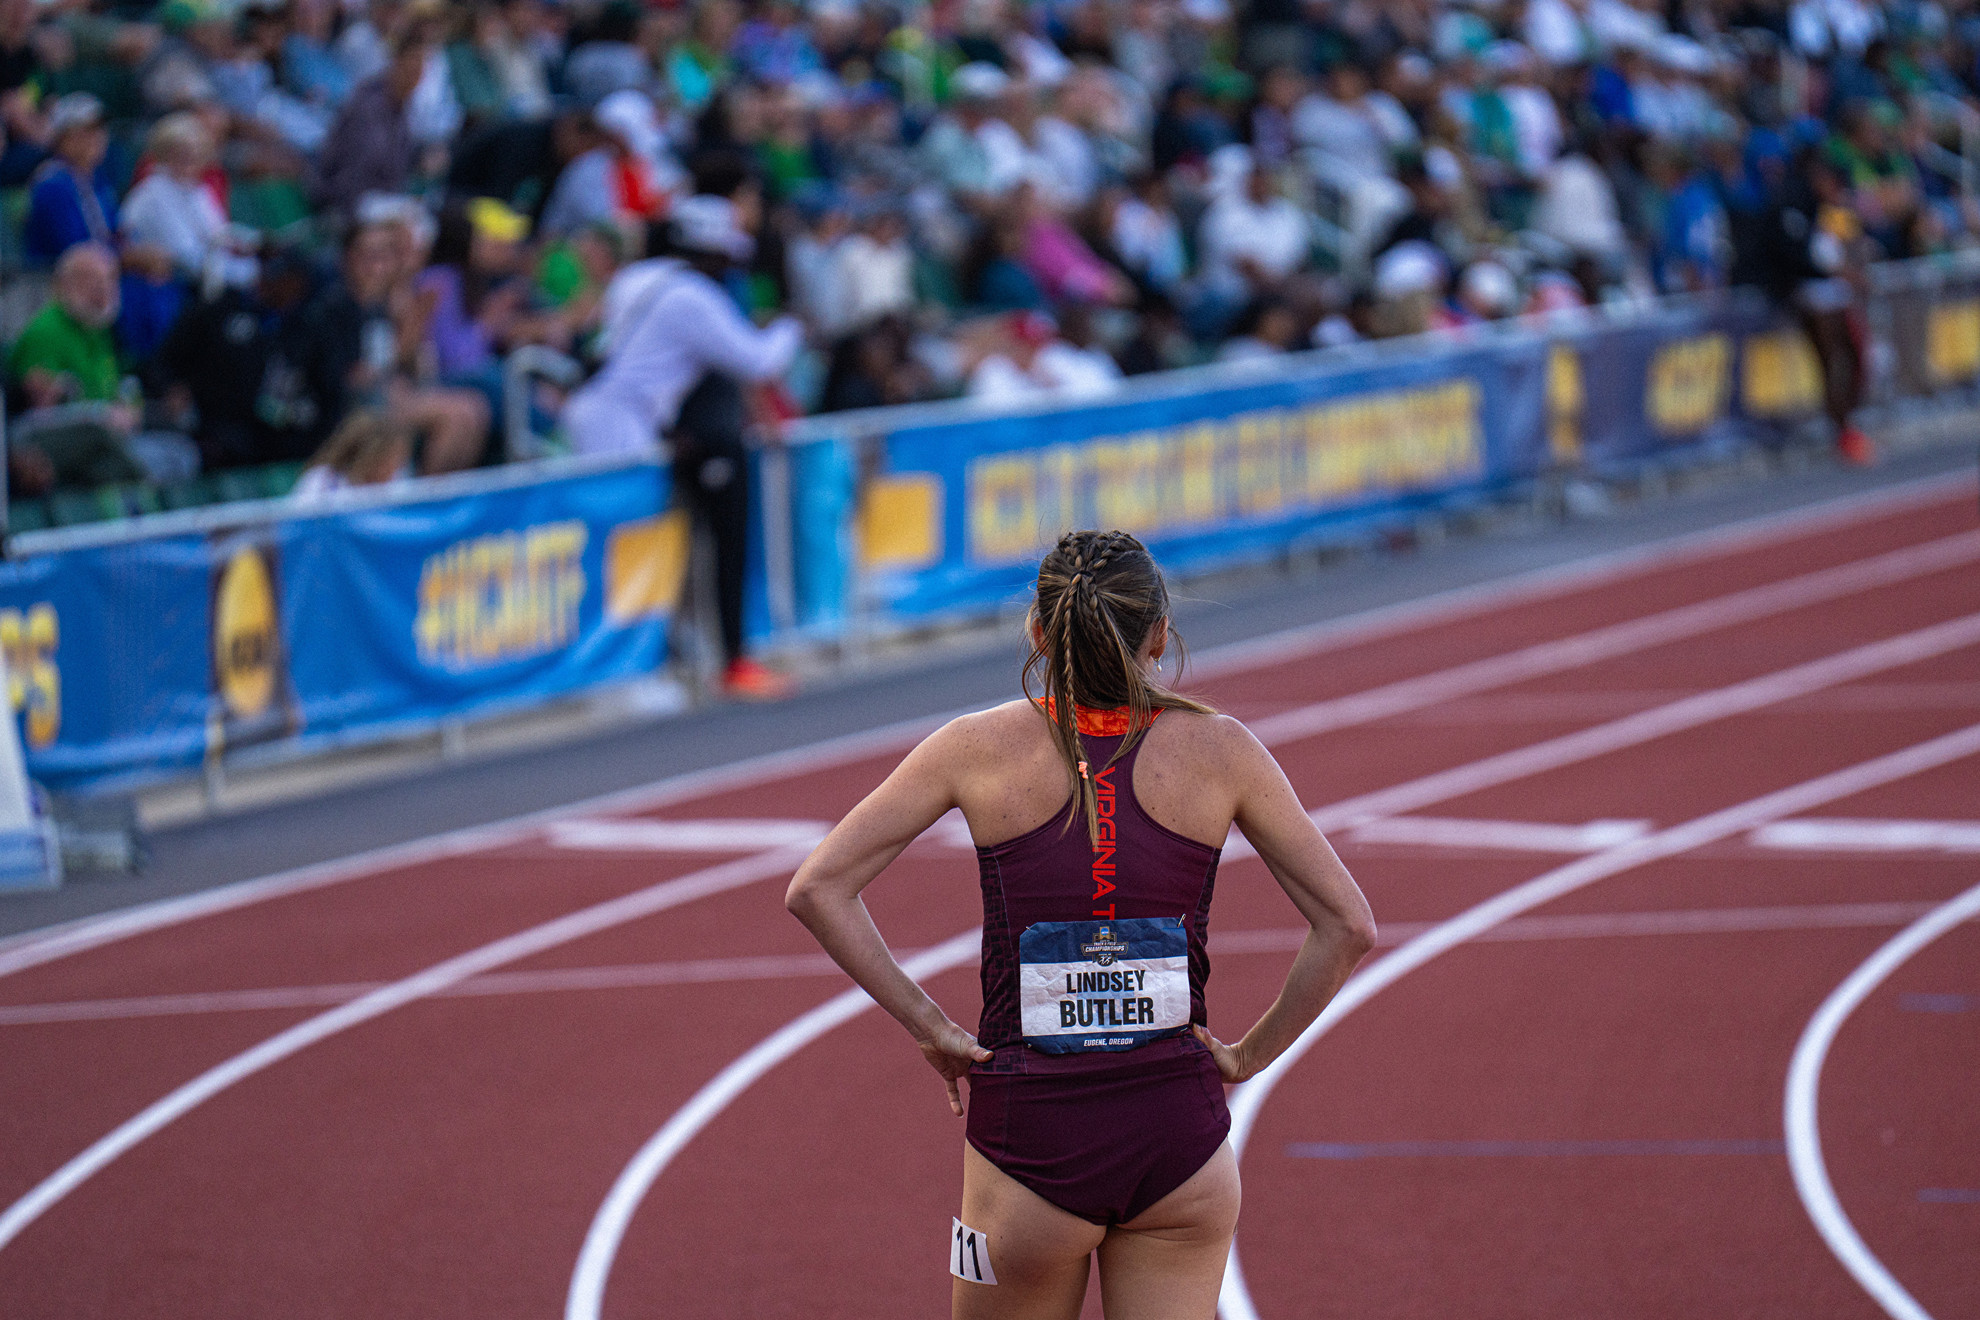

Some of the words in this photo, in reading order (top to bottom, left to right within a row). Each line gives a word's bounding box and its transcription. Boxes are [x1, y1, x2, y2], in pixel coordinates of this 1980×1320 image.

[1066, 969, 1146, 994] LINDSEY
[1059, 997, 1154, 1028] BUTLER
[1083, 1038, 1107, 1047] EUGENE,
[1108, 1037, 1134, 1045] OREGON
[956, 1225, 983, 1281] 11
